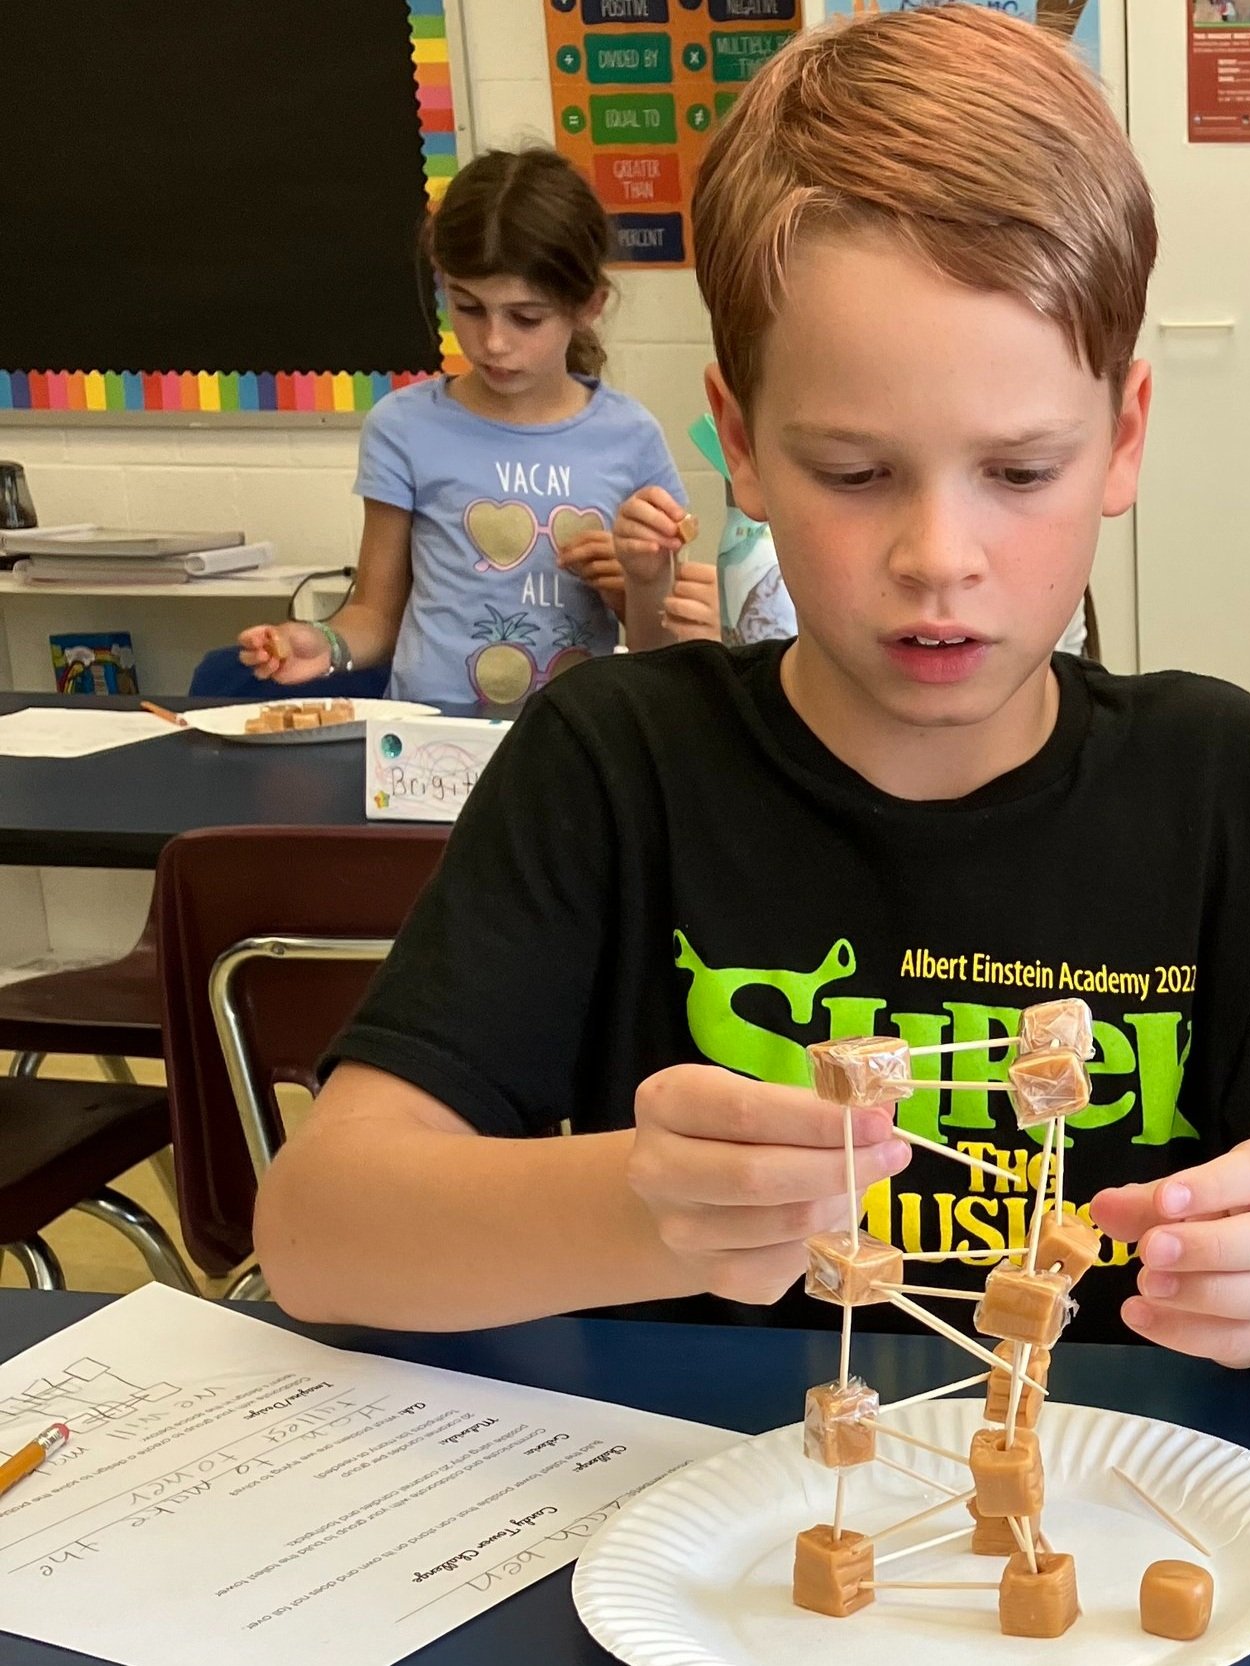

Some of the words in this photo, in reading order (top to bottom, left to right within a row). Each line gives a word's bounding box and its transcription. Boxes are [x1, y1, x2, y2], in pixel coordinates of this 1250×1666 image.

[644, 49, 660, 68] BY
[645, 109, 660, 126] TO
[495, 461, 571, 497] VACAY
[521, 571, 565, 608] ALL
[900, 948, 968, 981] Albert
[972, 953, 1054, 990] Einstein
[1058, 963, 1150, 1000] Academy
[234, 1456, 276, 1477] to
[572, 1444, 629, 1474] Challenge:
[367, 1507, 390, 1520] your
[511, 1504, 561, 1529] Candy
[336, 1519, 367, 1535] group
[437, 1517, 457, 1528] can
[407, 1528, 437, 1544] stand
[478, 1527, 523, 1550] Tower
[297, 1540, 327, 1555] build
[393, 1543, 409, 1552] on
[40, 1538, 101, 1577] the
[358, 1557, 383, 1570] own
[411, 1547, 482, 1585] Challenge
[336, 1569, 359, 1582] and
[215, 1580, 250, 1597] tower
[308, 1581, 337, 1596] does
[290, 1595, 311, 1607] not
[272, 1606, 293, 1616] fall
